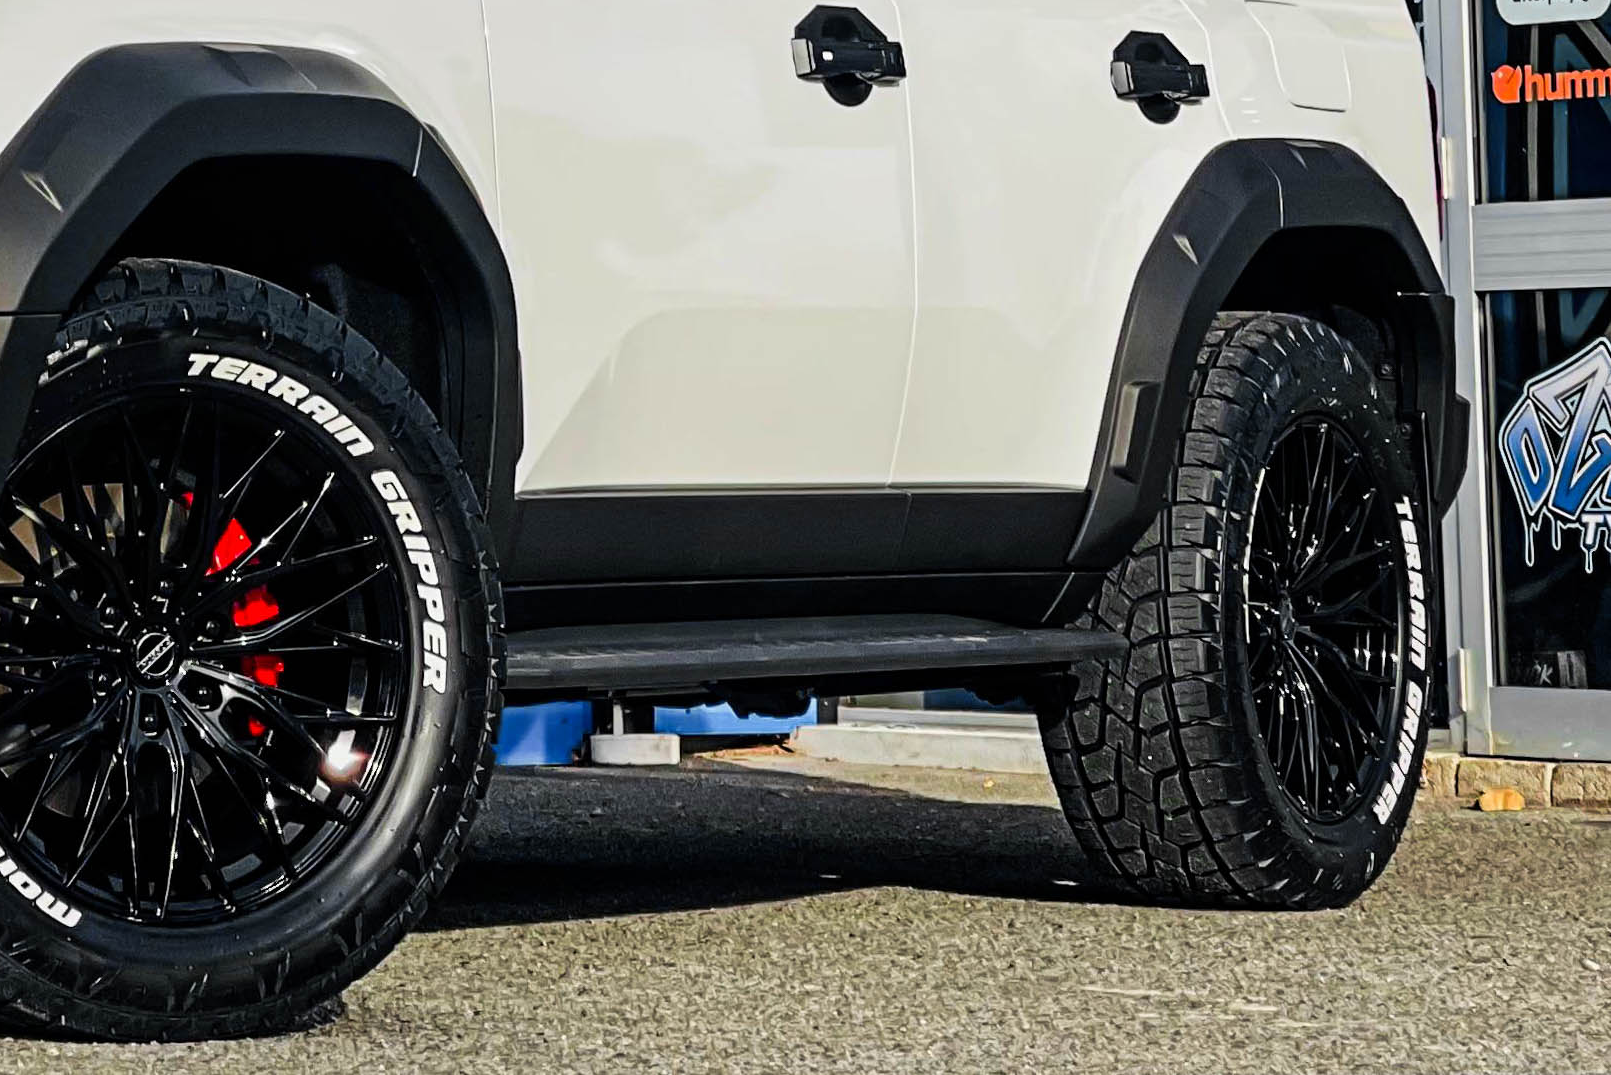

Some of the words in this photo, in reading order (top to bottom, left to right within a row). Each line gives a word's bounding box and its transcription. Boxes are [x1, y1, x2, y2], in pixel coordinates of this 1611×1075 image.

[187, 353, 375, 457] TERRAIN
[370, 469, 447, 694] GRIPPER
[1395, 495, 1426, 671] TERRAIN
